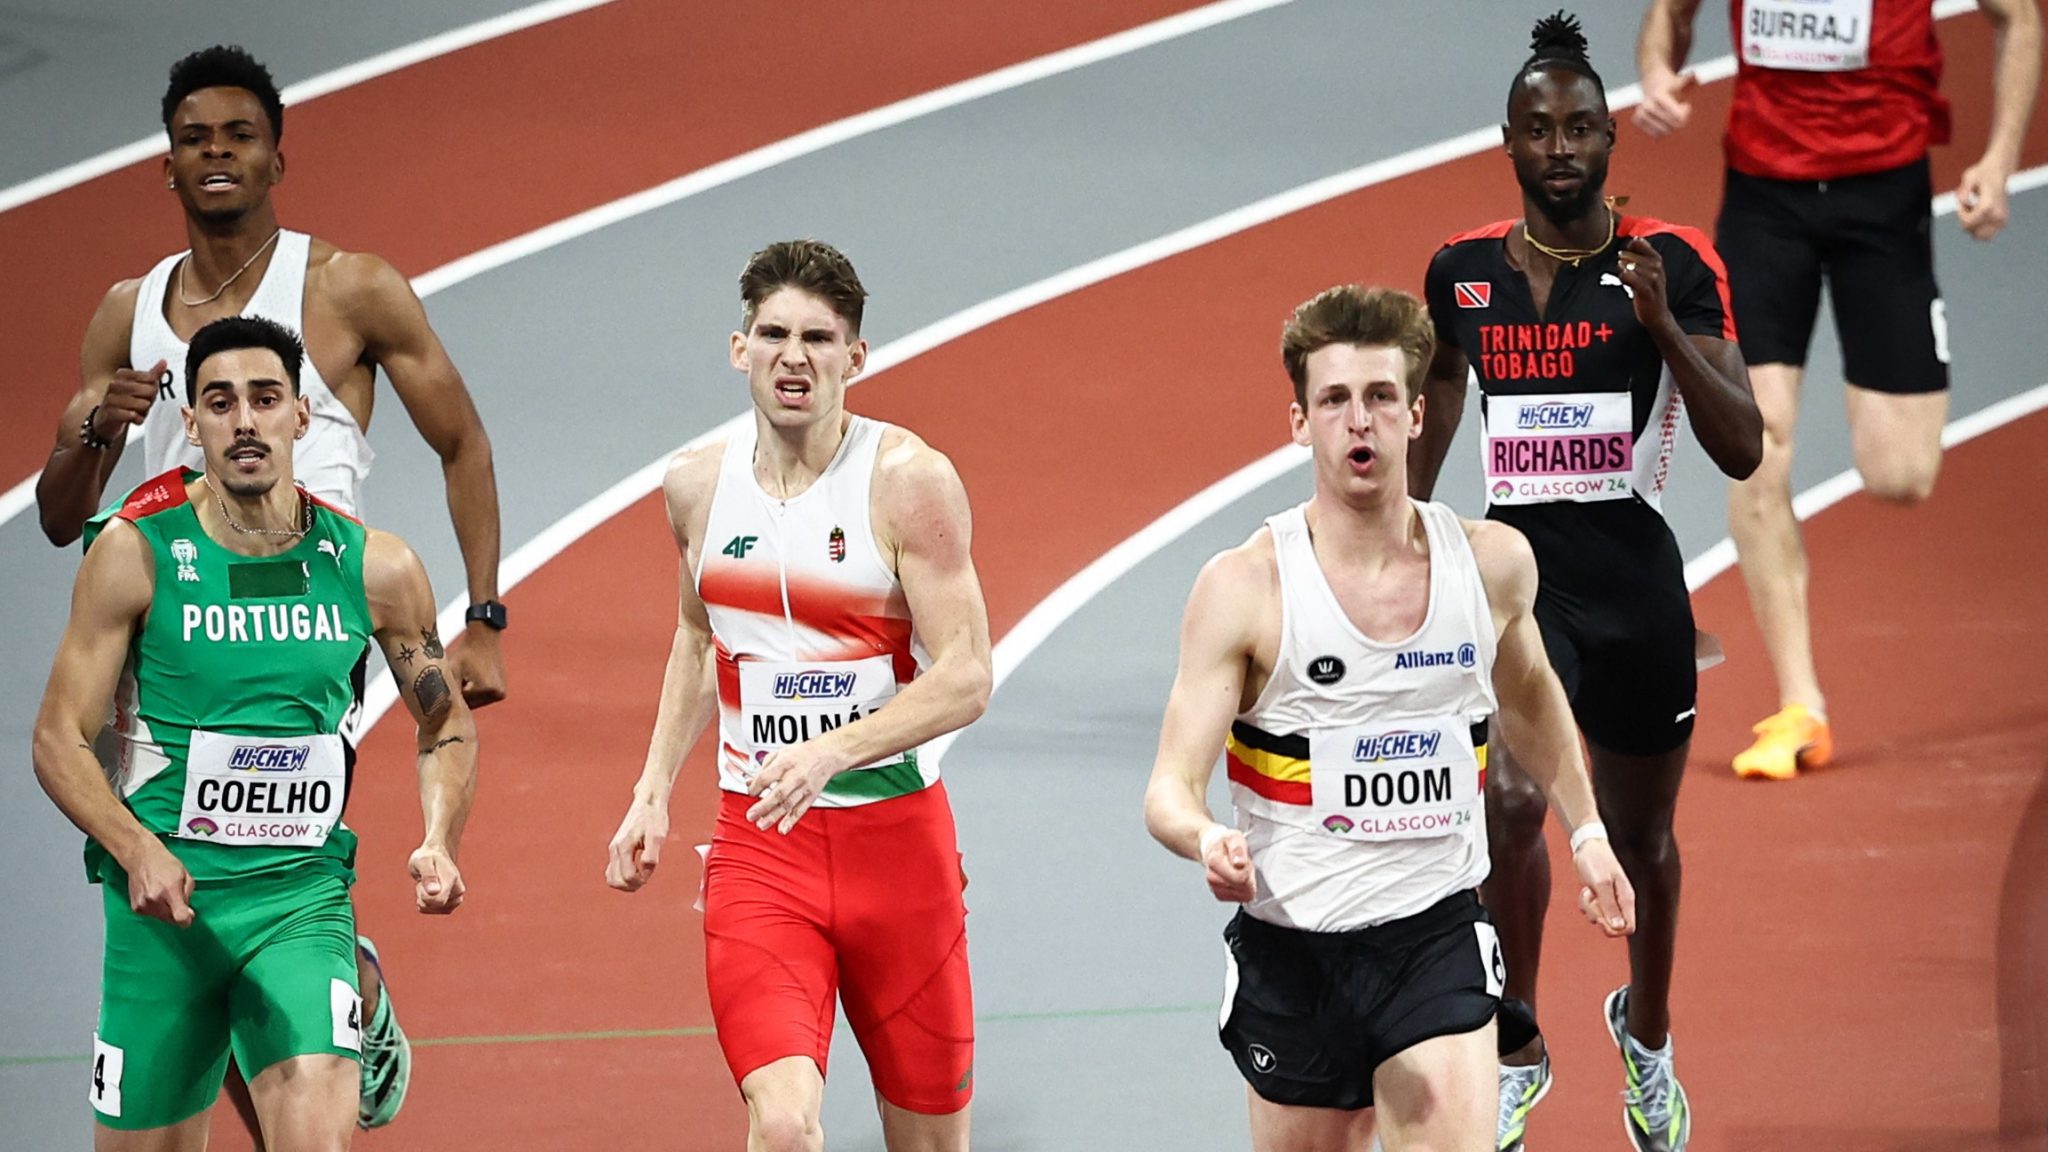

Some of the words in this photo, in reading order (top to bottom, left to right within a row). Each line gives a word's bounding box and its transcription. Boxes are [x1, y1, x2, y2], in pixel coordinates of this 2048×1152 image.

[1479, 322, 1591, 351] TRINIDAD
[1480, 351, 1575, 379] TOBAGO
[1516, 401, 1594, 429] HI-CHEW
[1494, 436, 1625, 473] RICHARDS
[1519, 479, 1604, 497] GLASGOW
[1608, 478, 1627, 493] 24
[722, 536, 759, 559] 4F
[177, 571, 200, 581] FPA
[182, 603, 350, 643] PORTUGAL
[1395, 650, 1454, 669] Allianz
[773, 671, 857, 699] HI-CHEW
[752, 703, 881, 745] MOLNÁ
[229, 745, 311, 771] HI-CHEW
[1353, 730, 1441, 762] HI-CHEW
[197, 779, 332, 814] COELHO
[1343, 766, 1451, 808] DOOM
[224, 822, 311, 838] GLASGOW
[1360, 814, 1451, 834] GLASGOW
[1455, 810, 1472, 826] 24
